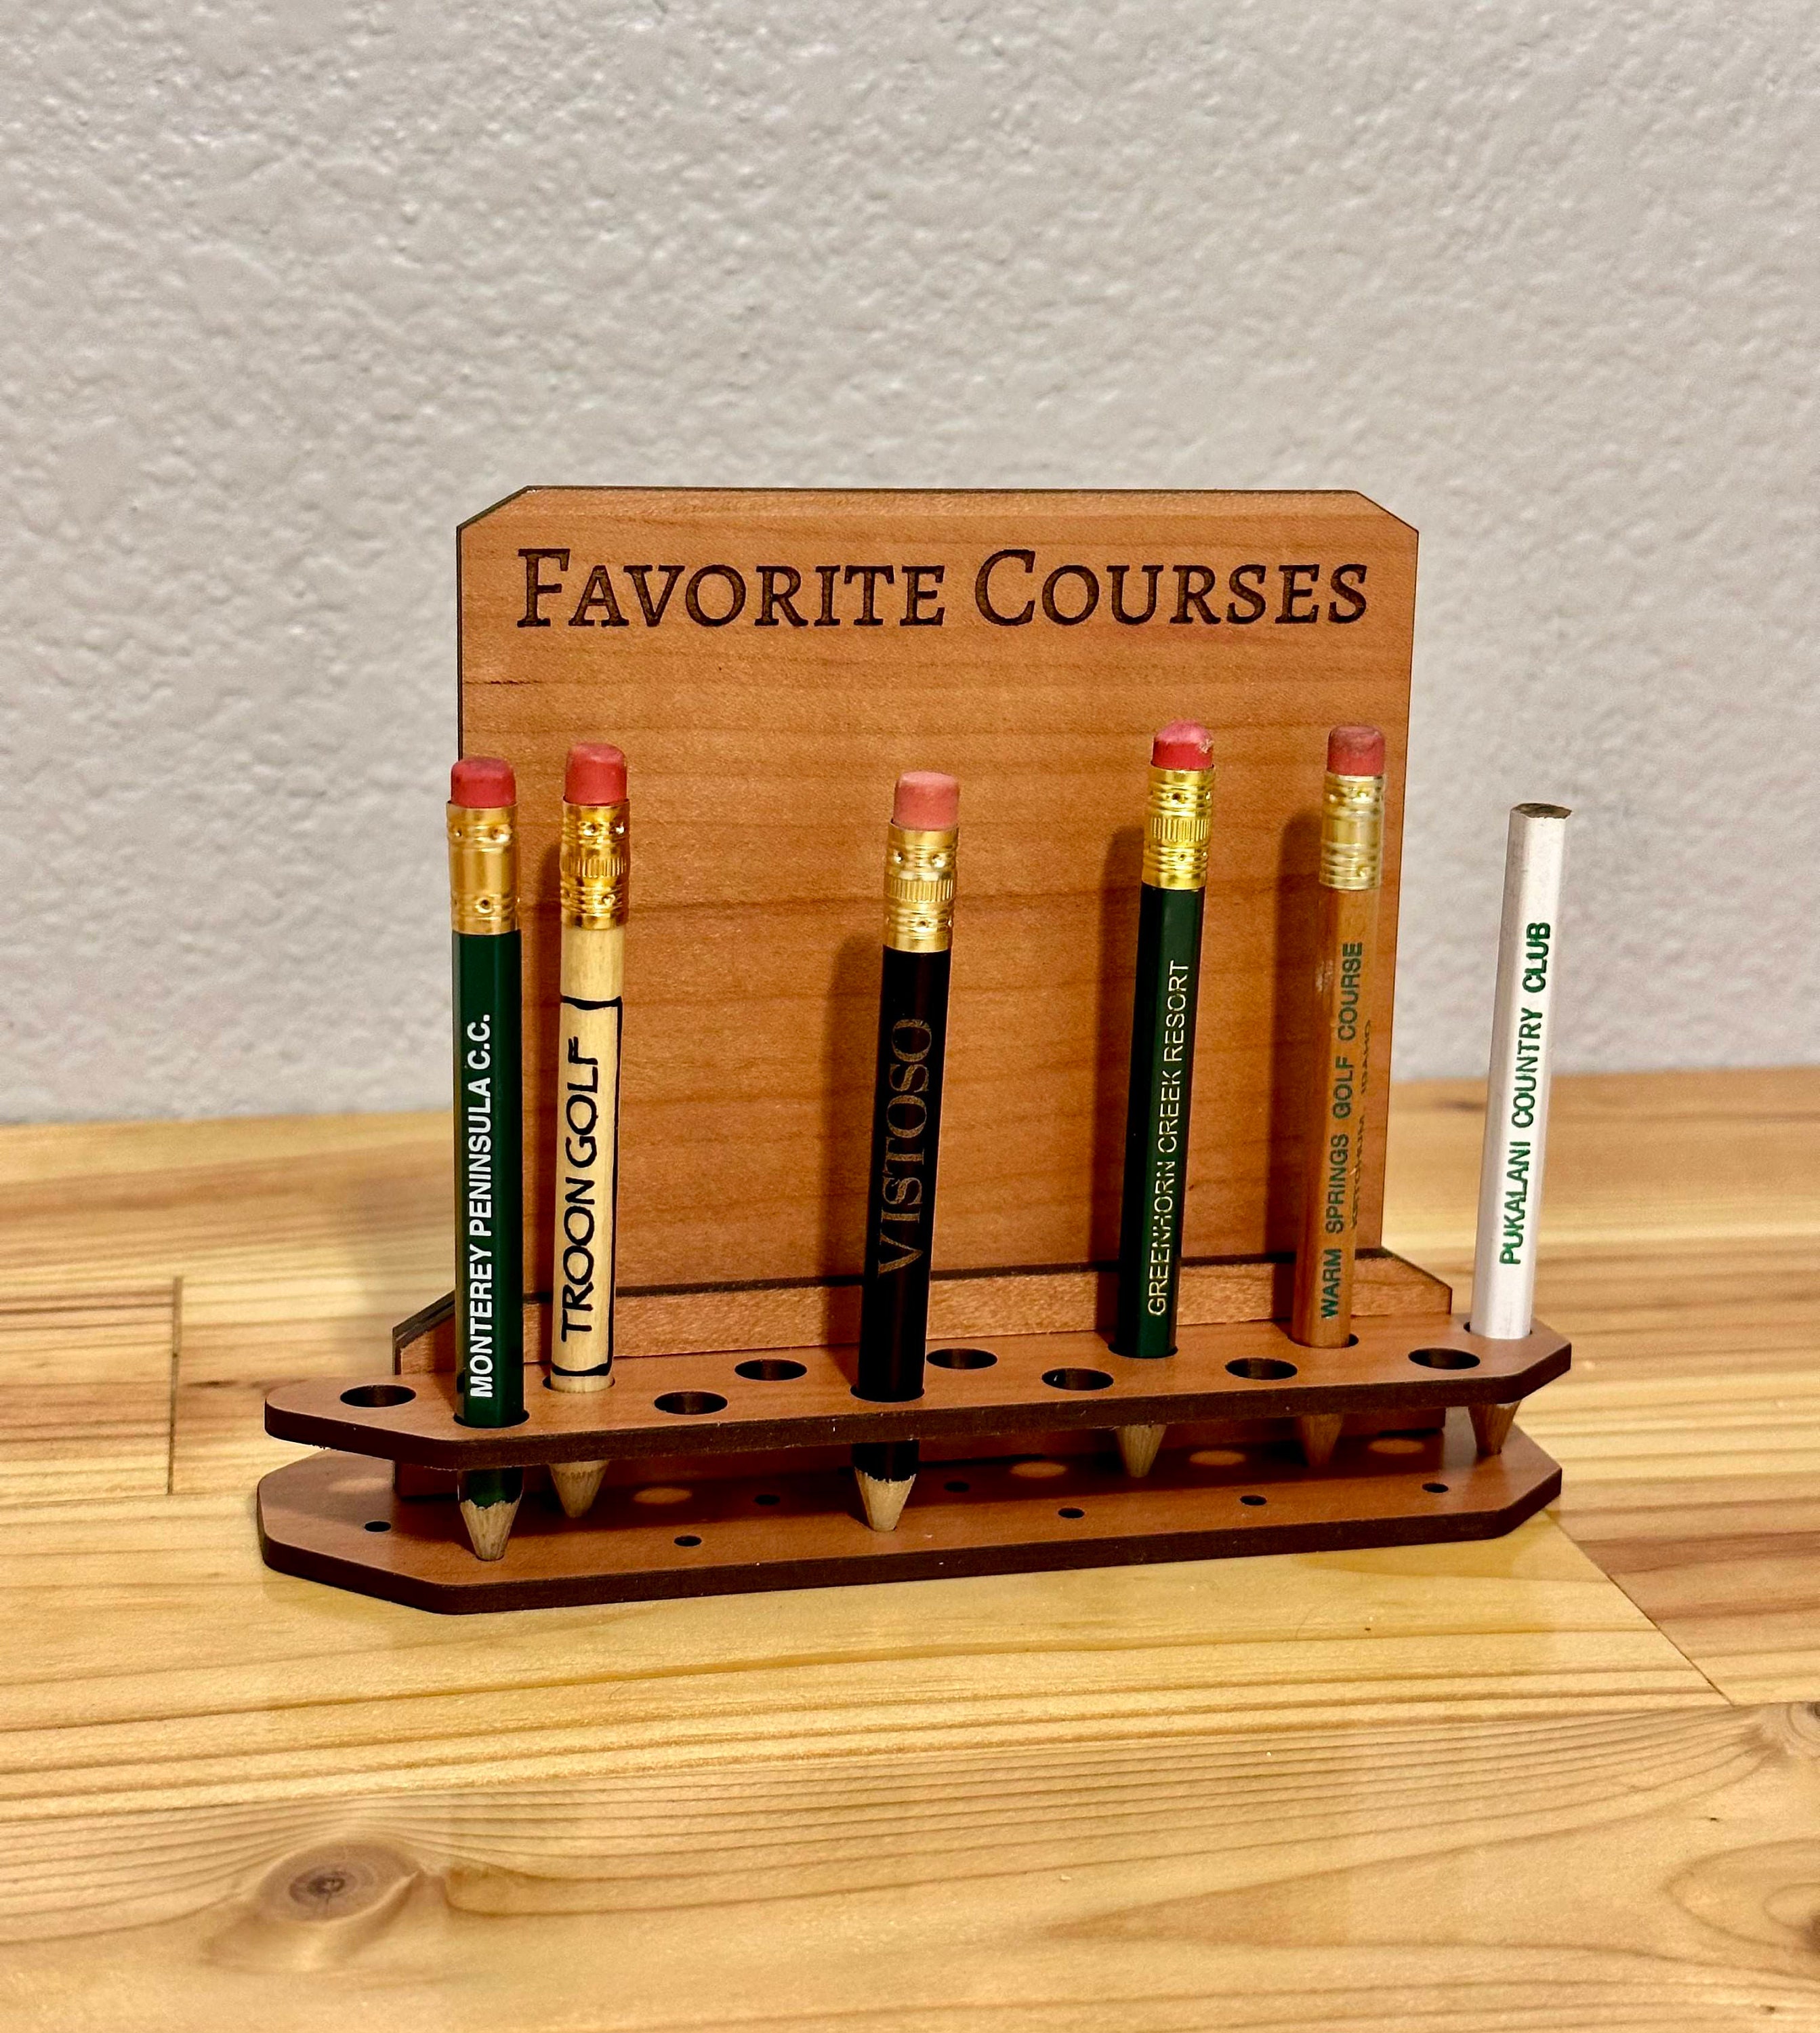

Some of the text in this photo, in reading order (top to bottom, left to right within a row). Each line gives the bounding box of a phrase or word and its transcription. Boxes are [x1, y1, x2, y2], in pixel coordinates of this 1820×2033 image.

[516, 548, 1369, 629] FAVORITE COURSES
[467, 1014, 493, 1398] MONTEREY PENINSULA C.C.
[561, 1036, 599, 1342] TROON GOLF
[877, 1019, 932, 1278] VISTOSO
[1147, 960, 1188, 1316] GREENHORN CREEK RESORT
[1321, 942, 1363, 1319] WARM SPRINGS GOLF COURSE
[1500, 922, 1551, 1265] PUKALANI COUNTRY CLUB
